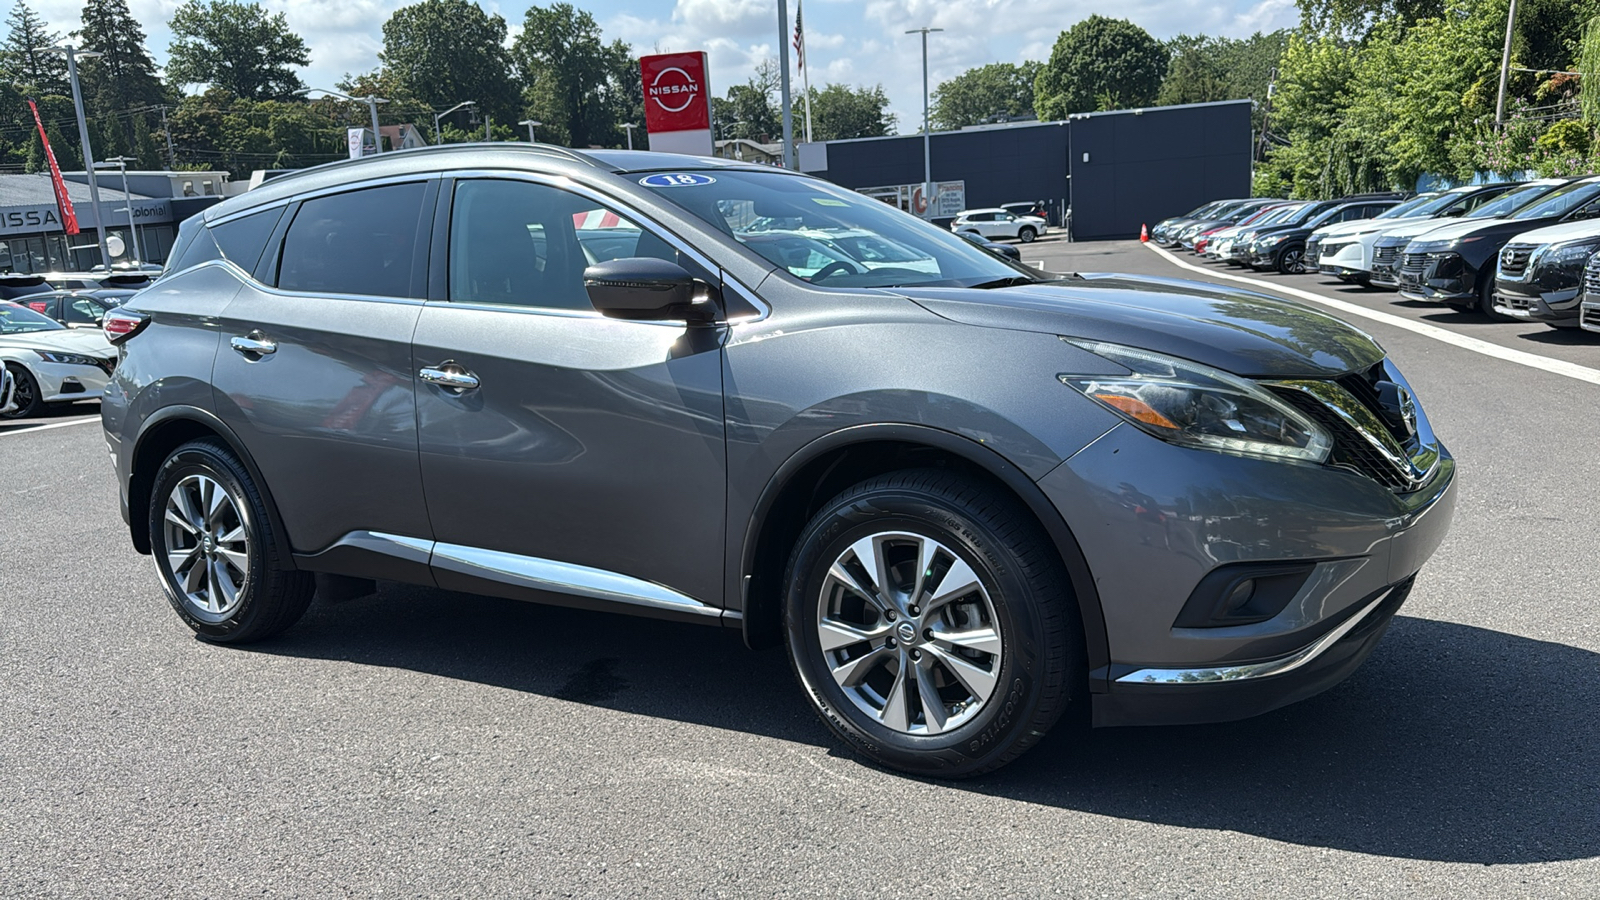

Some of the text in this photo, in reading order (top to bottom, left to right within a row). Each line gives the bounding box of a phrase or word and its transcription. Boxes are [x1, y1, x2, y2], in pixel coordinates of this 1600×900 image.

[649, 84, 699, 96] NISSAN
[662, 174, 697, 186] 18
[0, 210, 58, 228] ISSA
